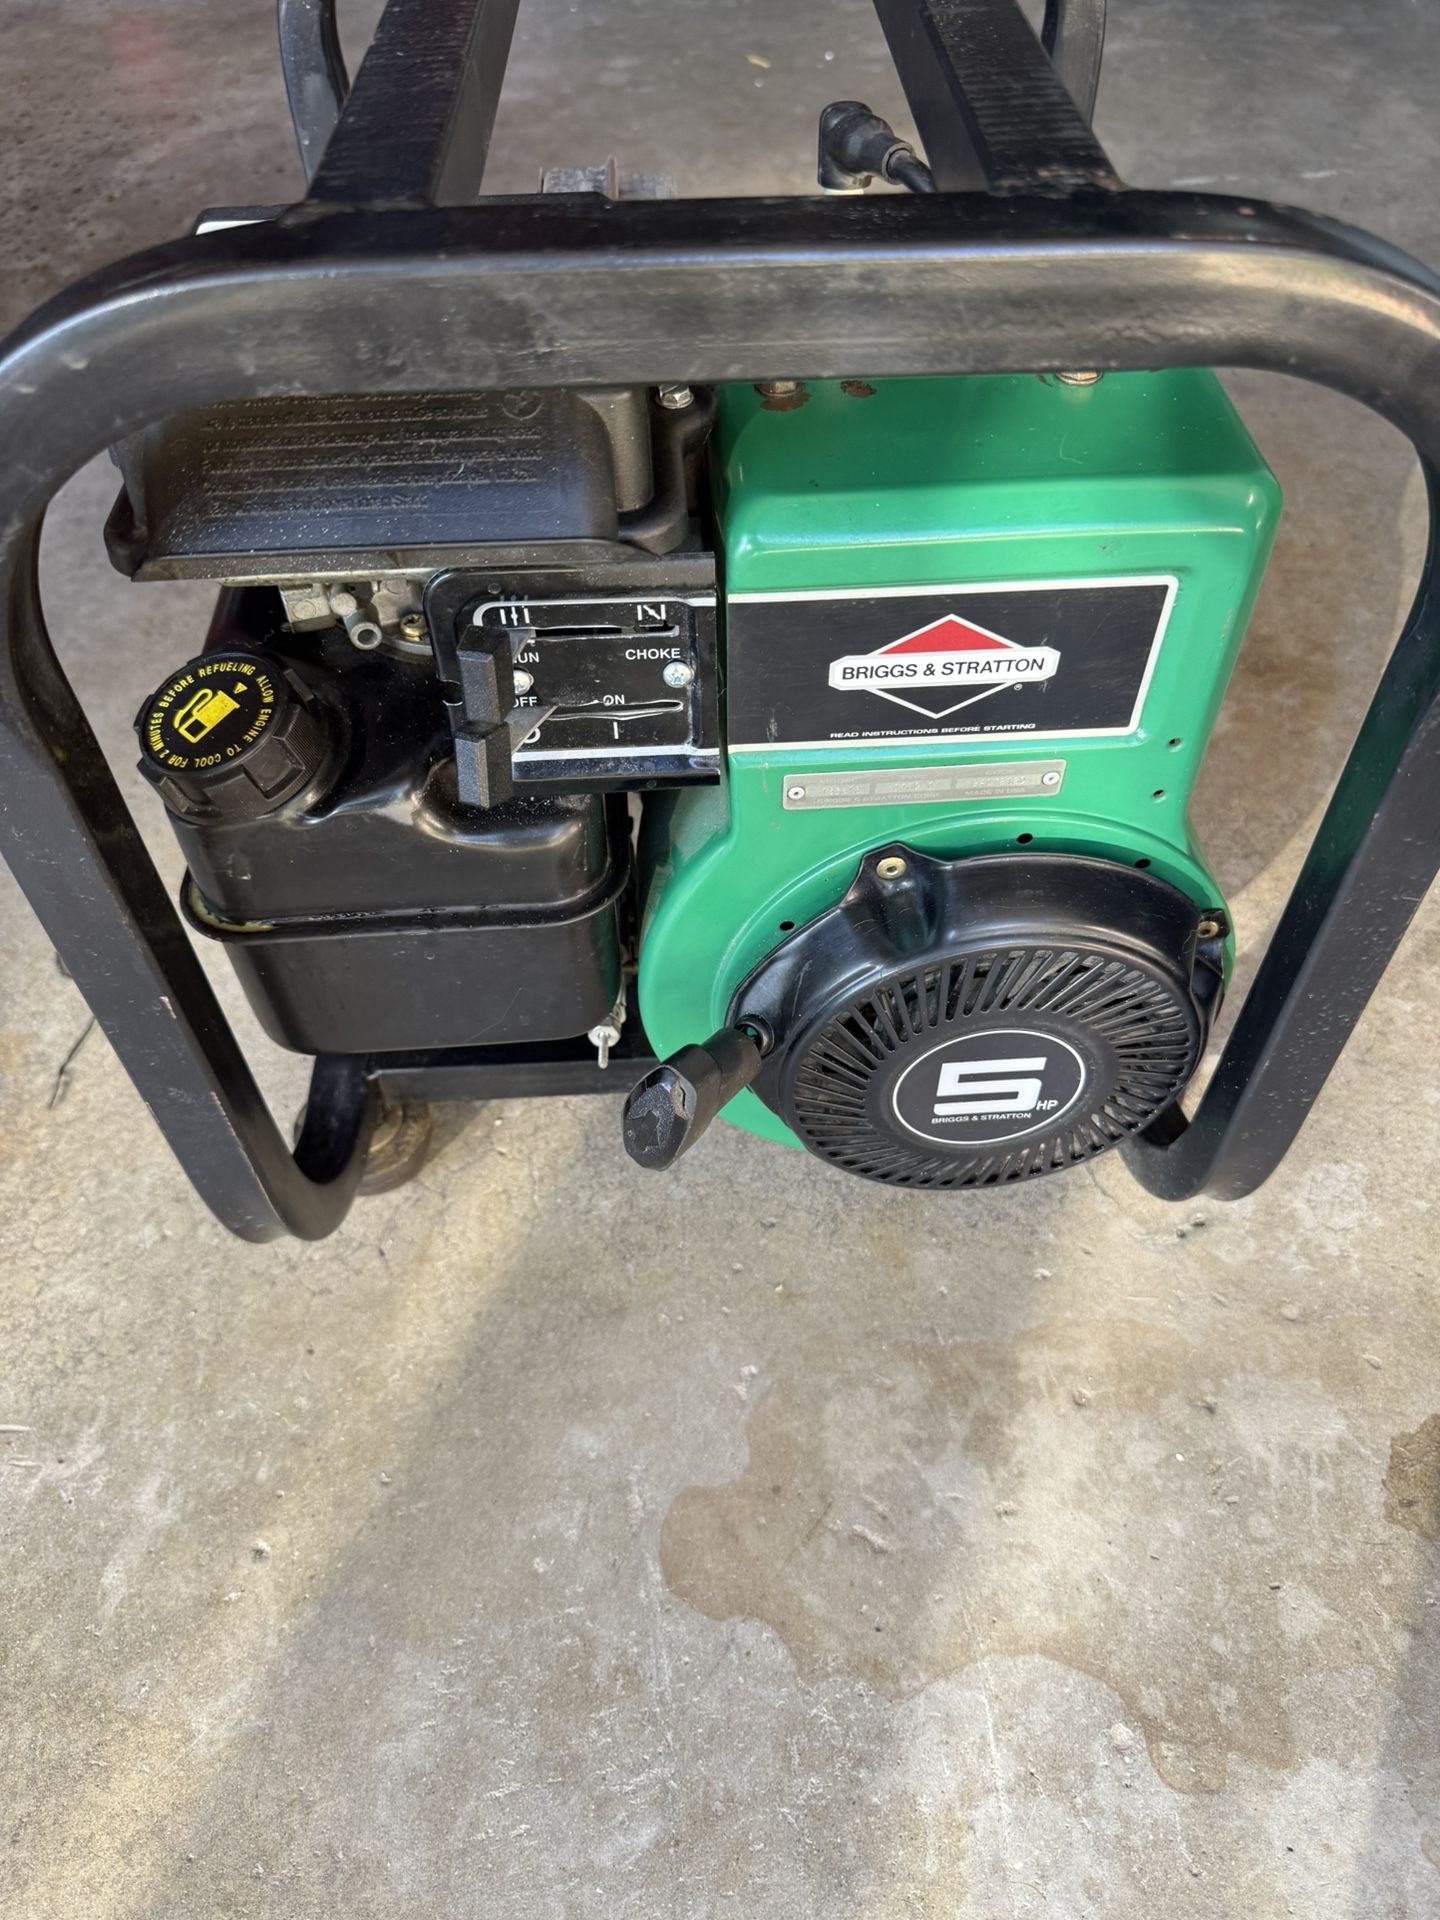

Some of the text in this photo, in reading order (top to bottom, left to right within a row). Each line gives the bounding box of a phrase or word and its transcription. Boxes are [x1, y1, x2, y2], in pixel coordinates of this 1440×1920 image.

[625, 648, 681, 660] CHOKE
[198, 661, 256, 678] REFUELING
[842, 658, 1045, 680] BRIGGS & STRATTON
[158, 674, 195, 708] BEFORE
[256, 675, 274, 703] ALLOW
[602, 694, 625, 706] ON
[149, 712, 165, 752] MINUTES
[243, 708, 272, 743] ENGINE
[862, 728, 939, 737] INSTRUCTIONS
[941, 726, 981, 734] BEFORE
[983, 723, 1036, 732] STARTING
[226, 744, 242, 757] TO
[167, 754, 189, 768] FOR
[194, 753, 222, 768] COOL
[933, 1057, 1047, 1116] 5
[1035, 1100, 1058, 1111] HP
[931, 1112, 1033, 1125] BRIGGS & STRATTON
